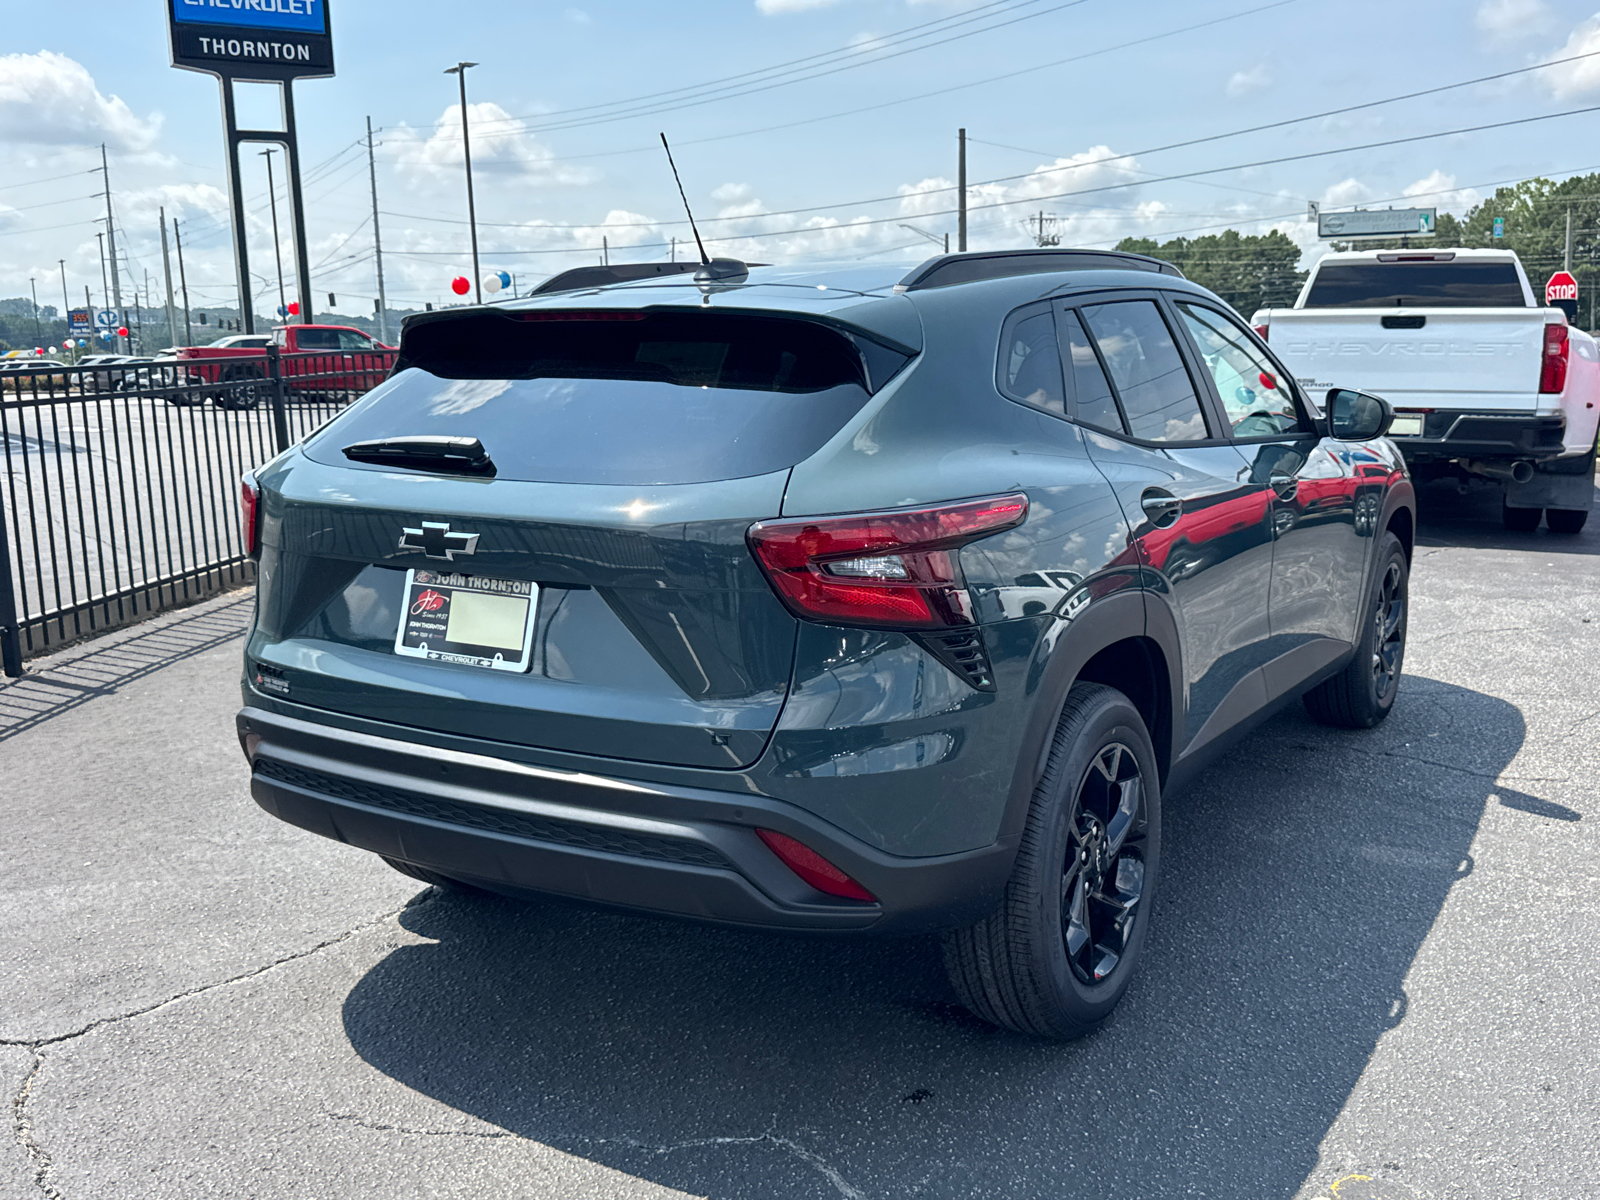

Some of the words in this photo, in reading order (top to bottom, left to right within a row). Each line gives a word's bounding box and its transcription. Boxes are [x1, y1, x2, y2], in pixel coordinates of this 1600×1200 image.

[184, 0, 316, 15] VROLET
[199, 37, 310, 61] THORNTON
[1548, 284, 1576, 301] STOP
[1286, 341, 1524, 357] CHEVROLET
[436, 574, 466, 587] JOHN
[467, 577, 530, 594] THORNTON
[441, 654, 479, 665] CHEVROLET
